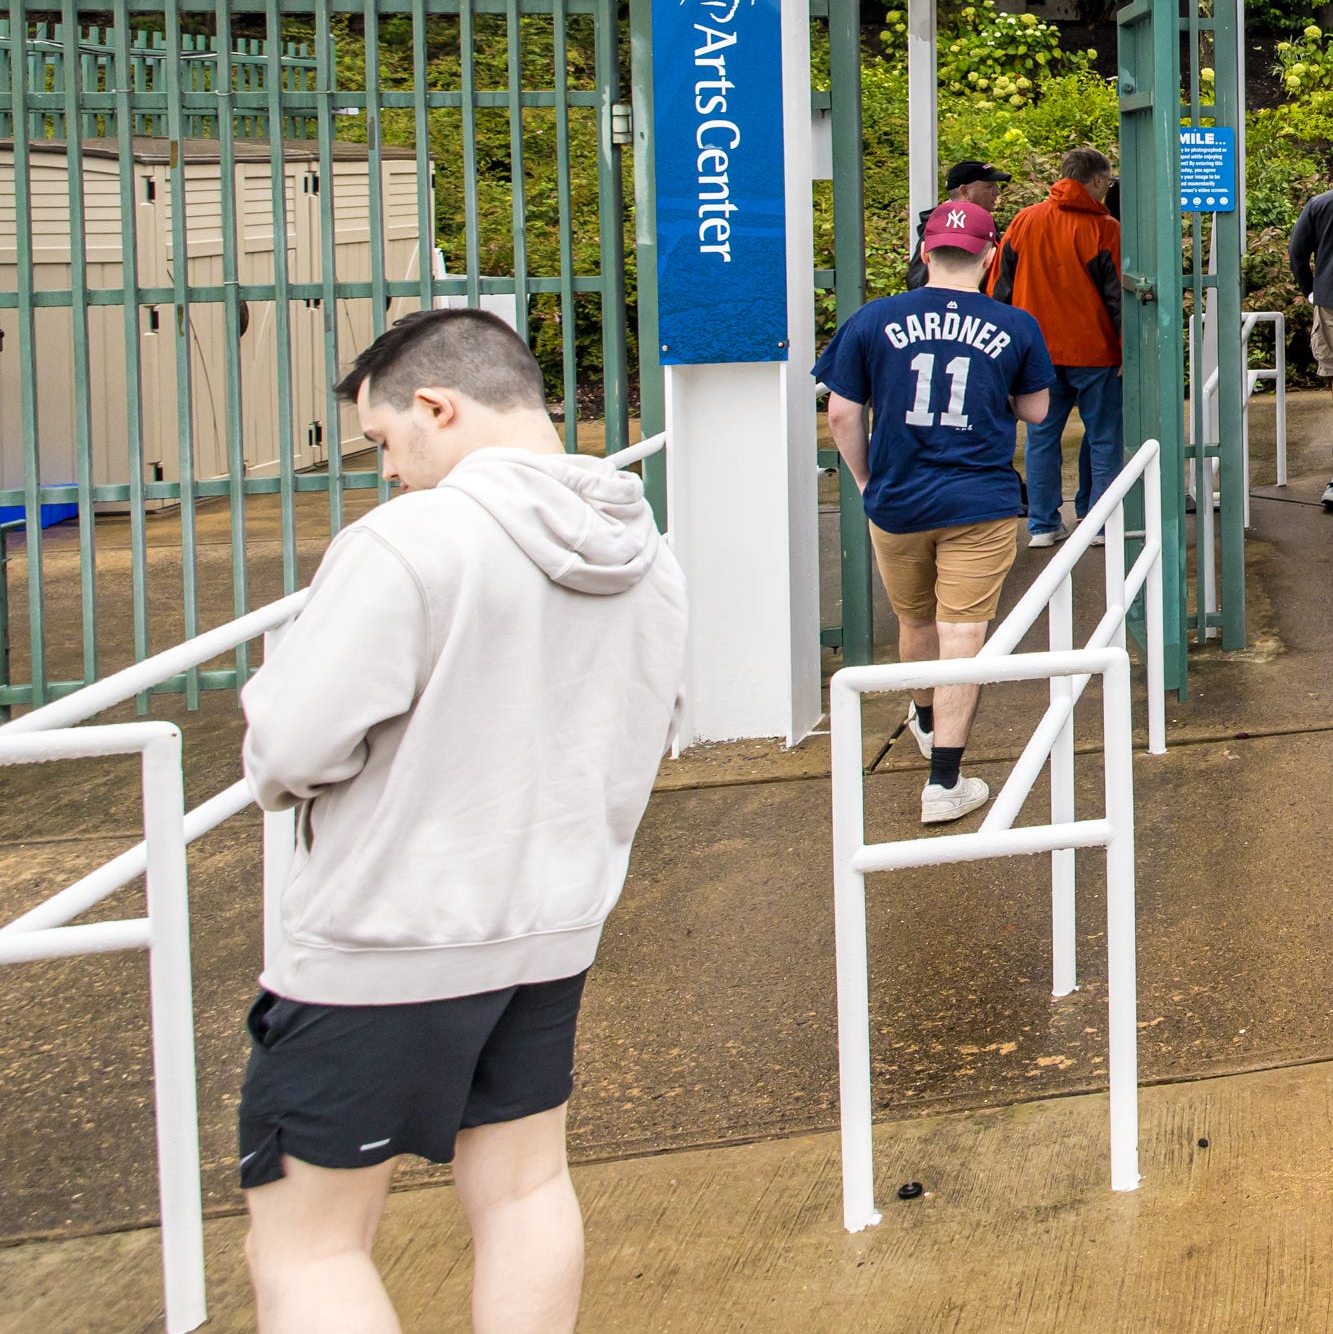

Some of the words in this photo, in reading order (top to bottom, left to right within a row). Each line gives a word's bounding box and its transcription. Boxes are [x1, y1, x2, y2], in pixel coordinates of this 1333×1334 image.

[694, 23, 737, 113] Arts
[695, 120, 732, 263] Center
[884, 312, 1011, 359] GARDNER
[905, 353, 971, 427] 11
